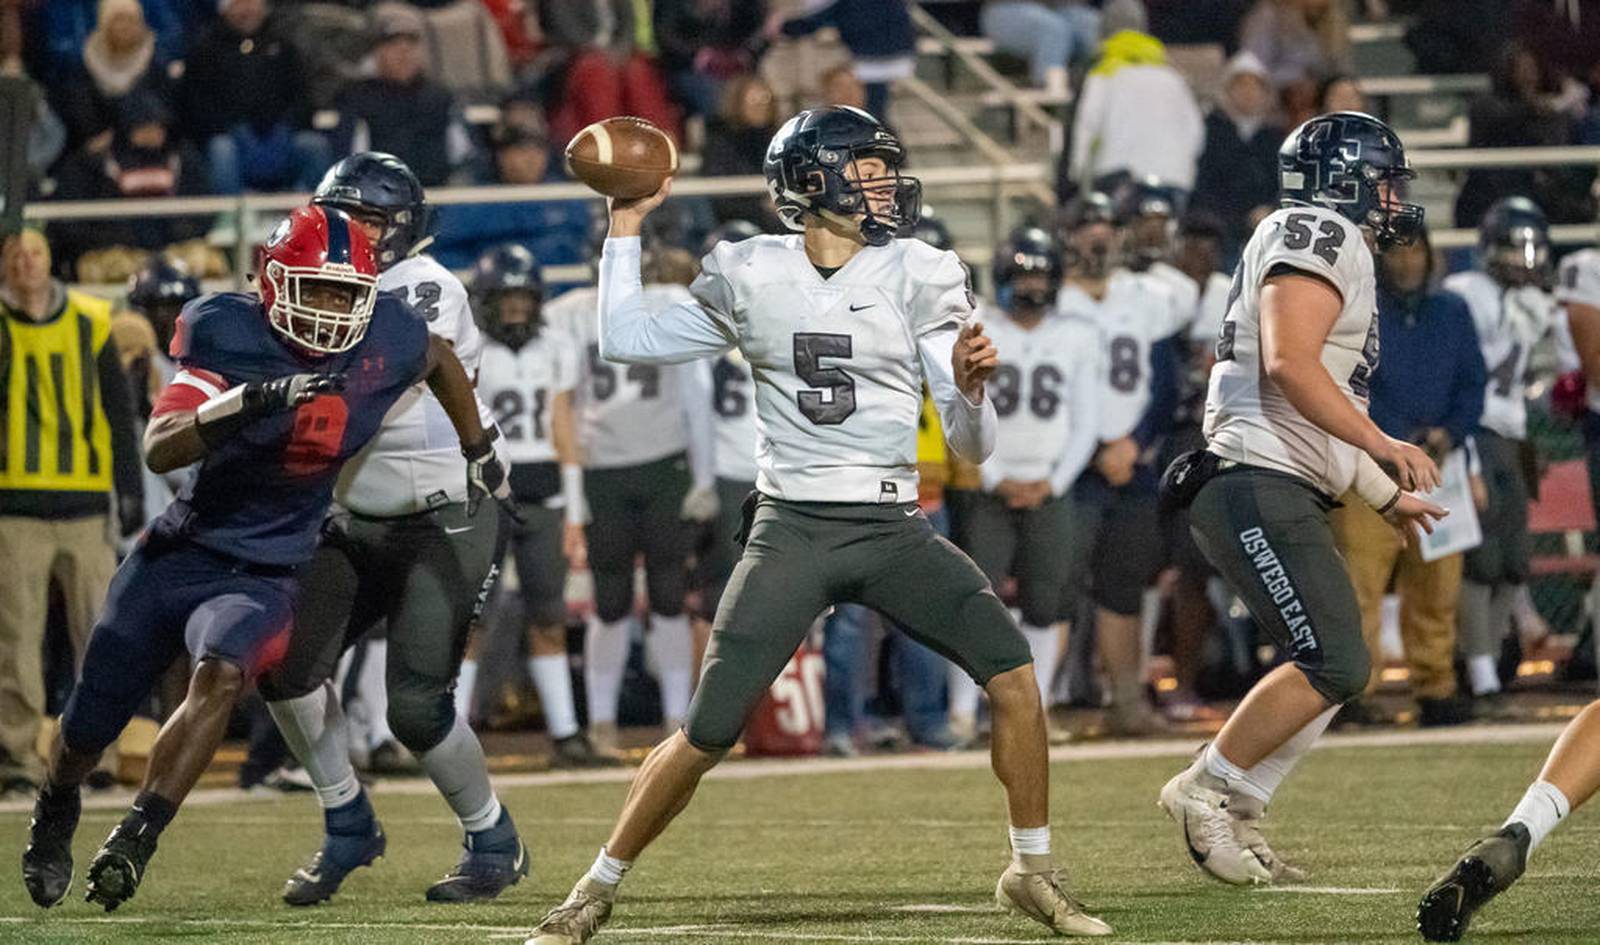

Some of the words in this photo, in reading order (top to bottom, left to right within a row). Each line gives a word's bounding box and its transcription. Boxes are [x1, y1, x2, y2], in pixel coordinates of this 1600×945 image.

[1284, 213, 1346, 267] 52
[793, 333, 857, 425] 5
[1109, 335, 1140, 392] 8
[1240, 527, 1294, 605] OSWEGO
[1281, 600, 1317, 651] EAST
[770, 653, 826, 735] 50
